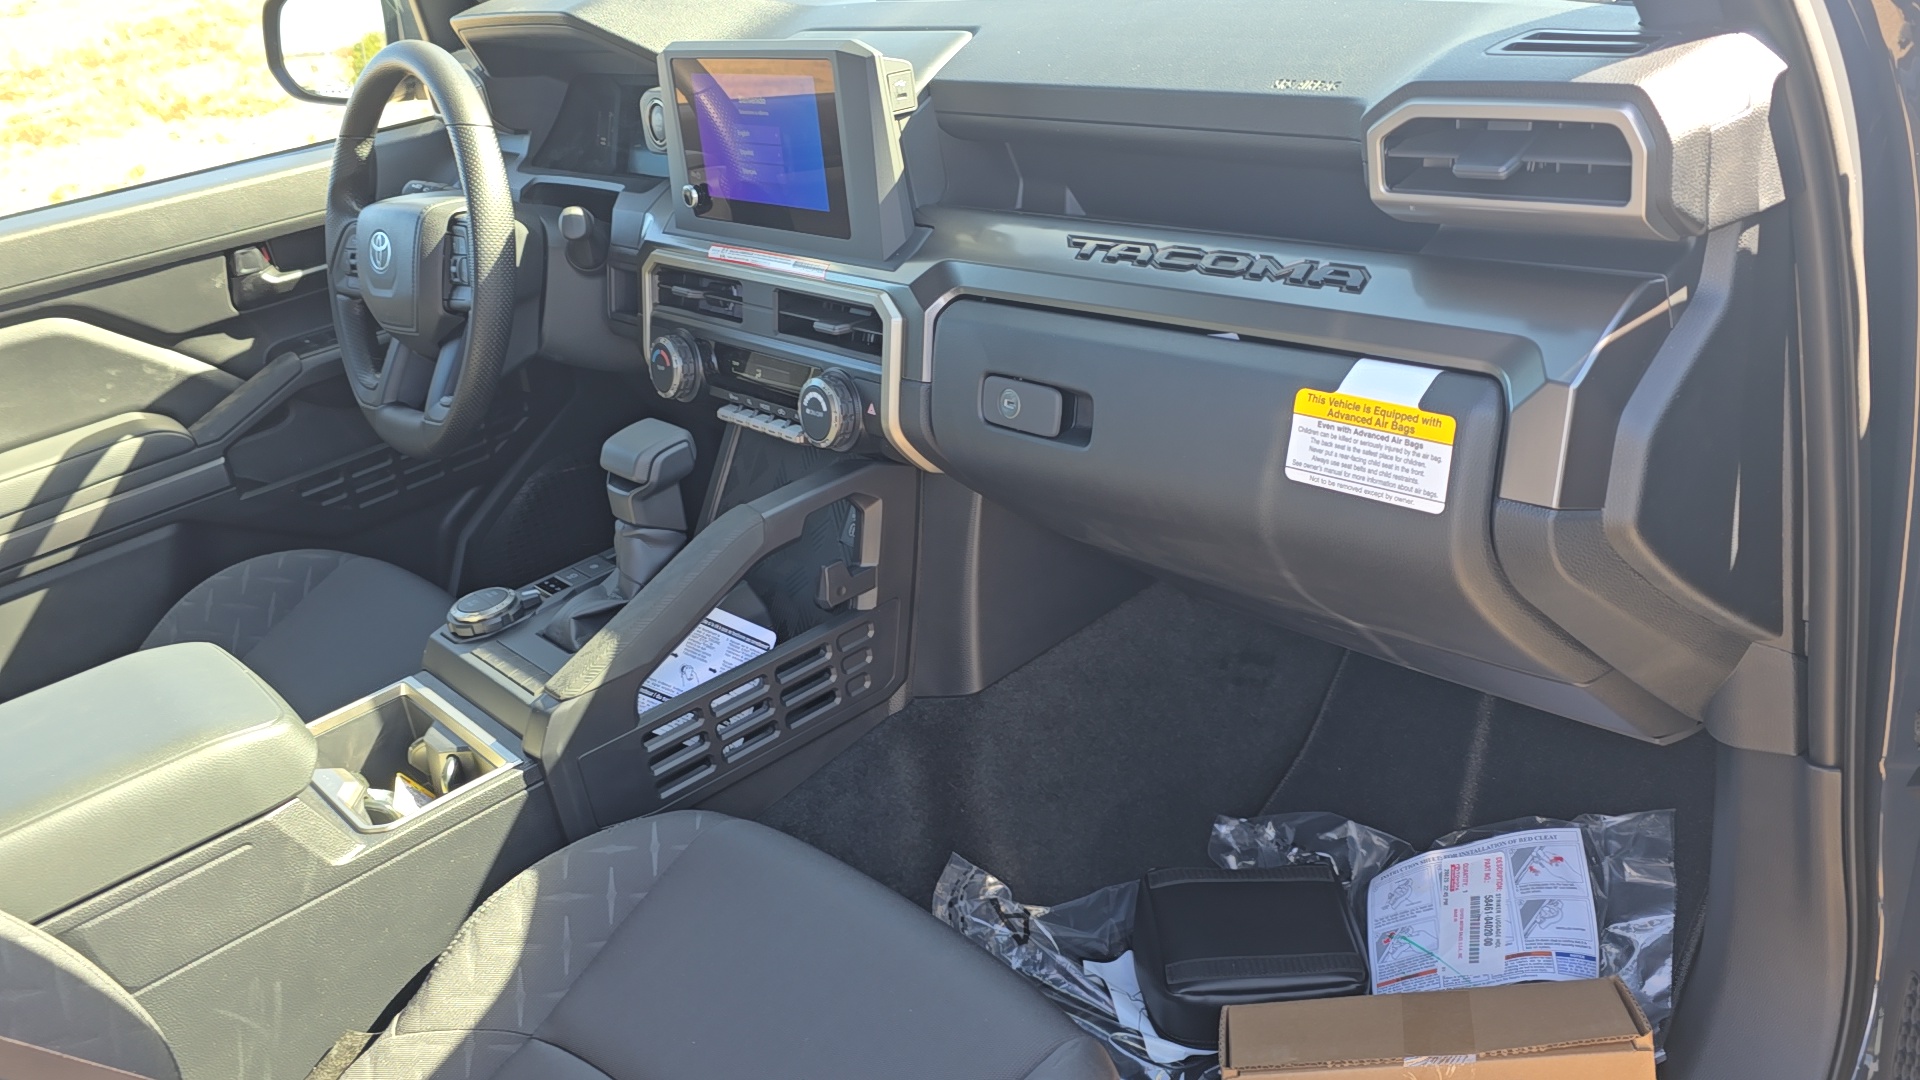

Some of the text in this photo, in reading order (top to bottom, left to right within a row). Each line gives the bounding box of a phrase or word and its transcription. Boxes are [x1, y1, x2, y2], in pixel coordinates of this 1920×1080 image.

[1066, 234, 1372, 295] TACOMA
[1307, 393, 1442, 428] This Vehicle is Equipped with
[1327, 408, 1416, 436] Advanced Air Bags
[1317, 421, 1424, 450] Even with Advanced Air Bags
[1337, 482, 1362, 492] removed
[1364, 489, 1384, 498] except
[1458, 840, 1507, 858] INSTALLATION
